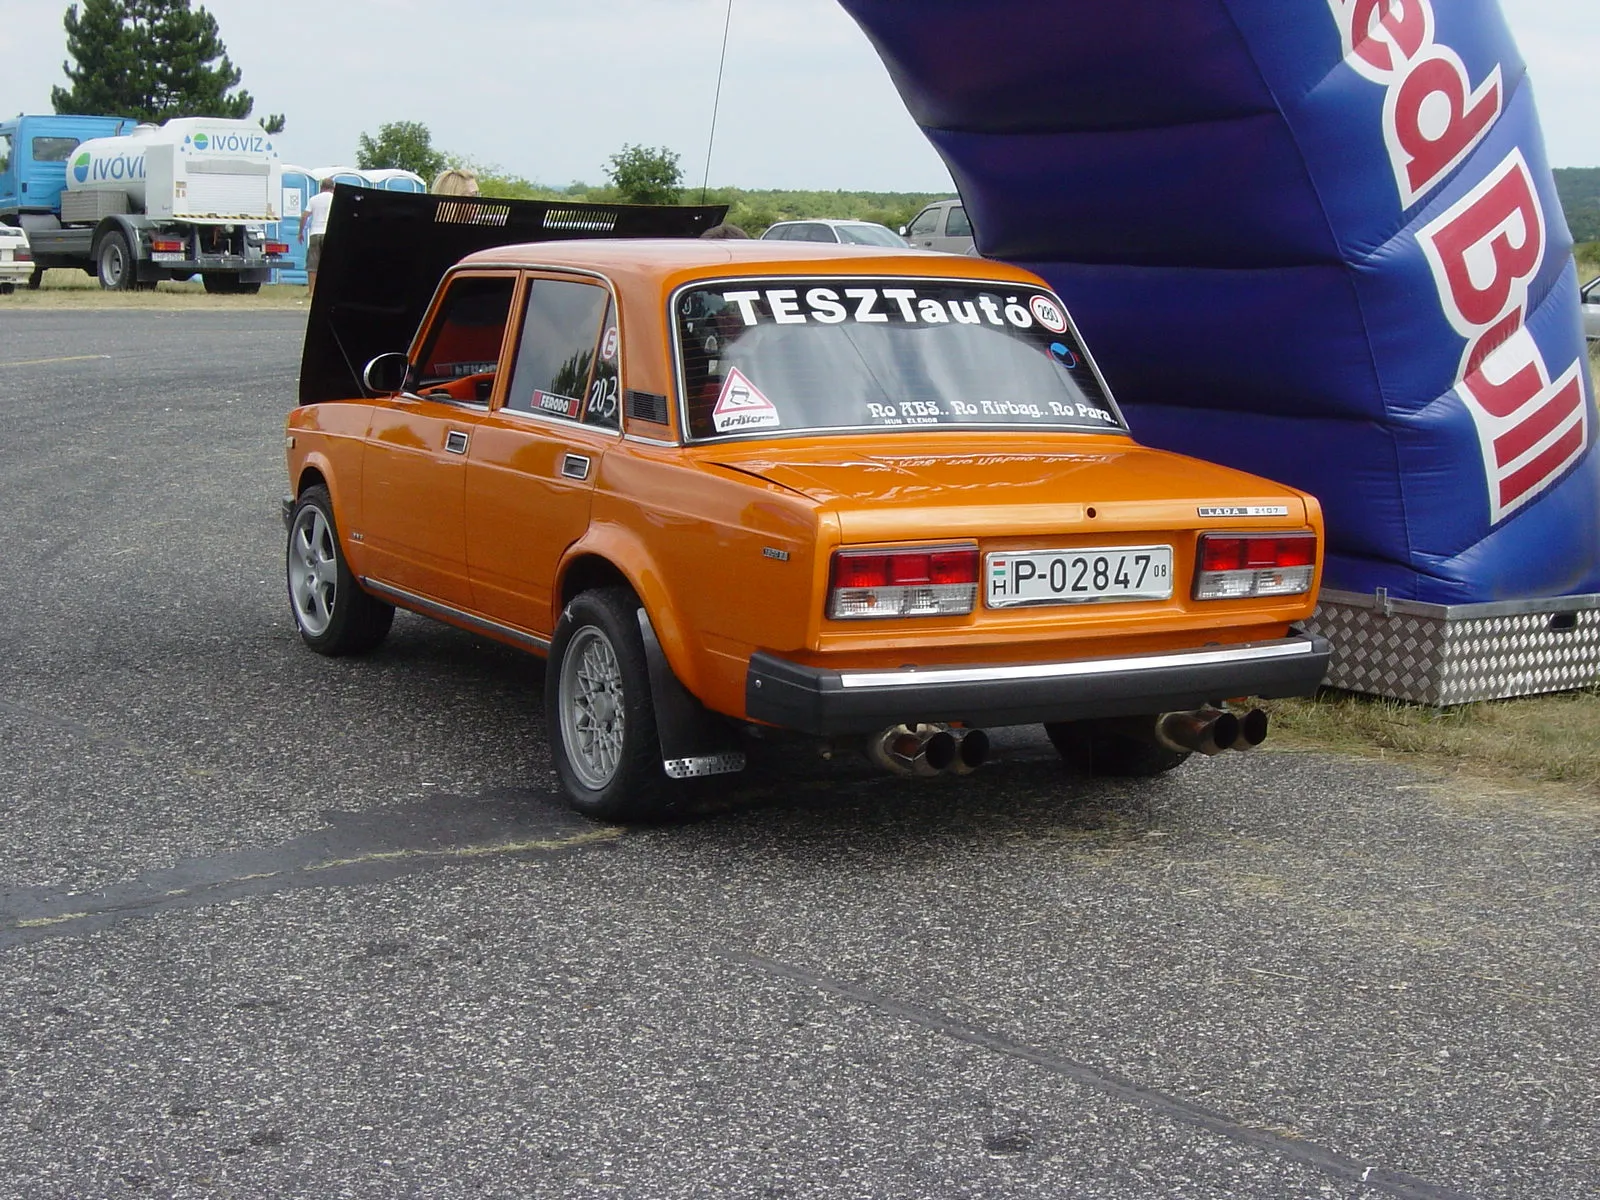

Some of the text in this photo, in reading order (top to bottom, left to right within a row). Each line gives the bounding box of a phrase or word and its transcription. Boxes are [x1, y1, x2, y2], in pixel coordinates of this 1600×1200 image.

[212, 132, 263, 153] IVÓVÍZ
[93, 151, 146, 180] IVÓVÍ
[1334, 0, 1586, 519] ed Bull
[722, 288, 1033, 328] TESZTautó
[540, 394, 569, 413] FERODO
[588, 376, 618, 418] 203
[866, 402, 897, 418] No
[950, 400, 978, 415] No
[1048, 401, 1074, 417] No
[1208, 507, 1280, 516] LADA 2107
[992, 554, 1167, 595] H P-02847 08
